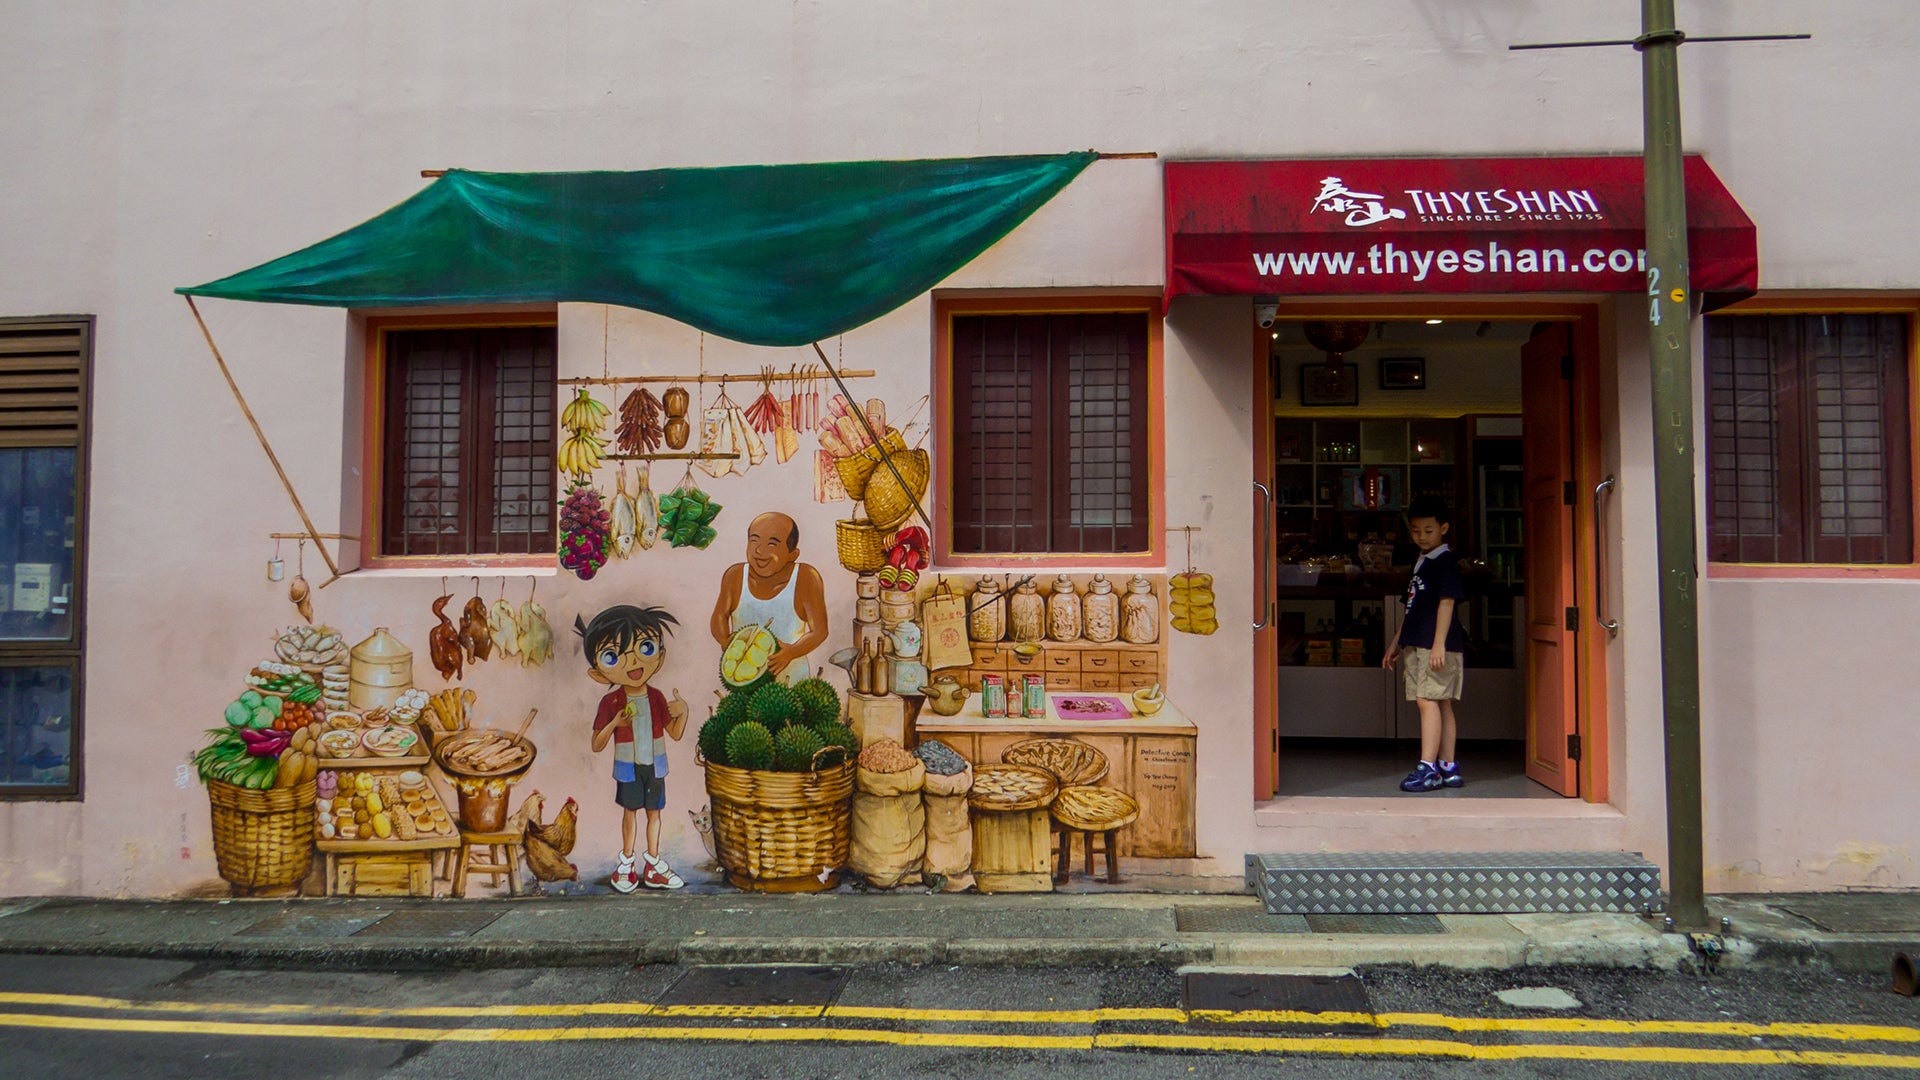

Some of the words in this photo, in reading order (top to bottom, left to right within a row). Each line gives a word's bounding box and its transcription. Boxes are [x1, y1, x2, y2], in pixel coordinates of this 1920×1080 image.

[1420, 214, 1502, 223] SINGAPORE
[1519, 213, 1562, 222] SINCE
[1568, 213, 1604, 221] 1955
[1252, 242, 1647, 282] www.thyeshan.co
